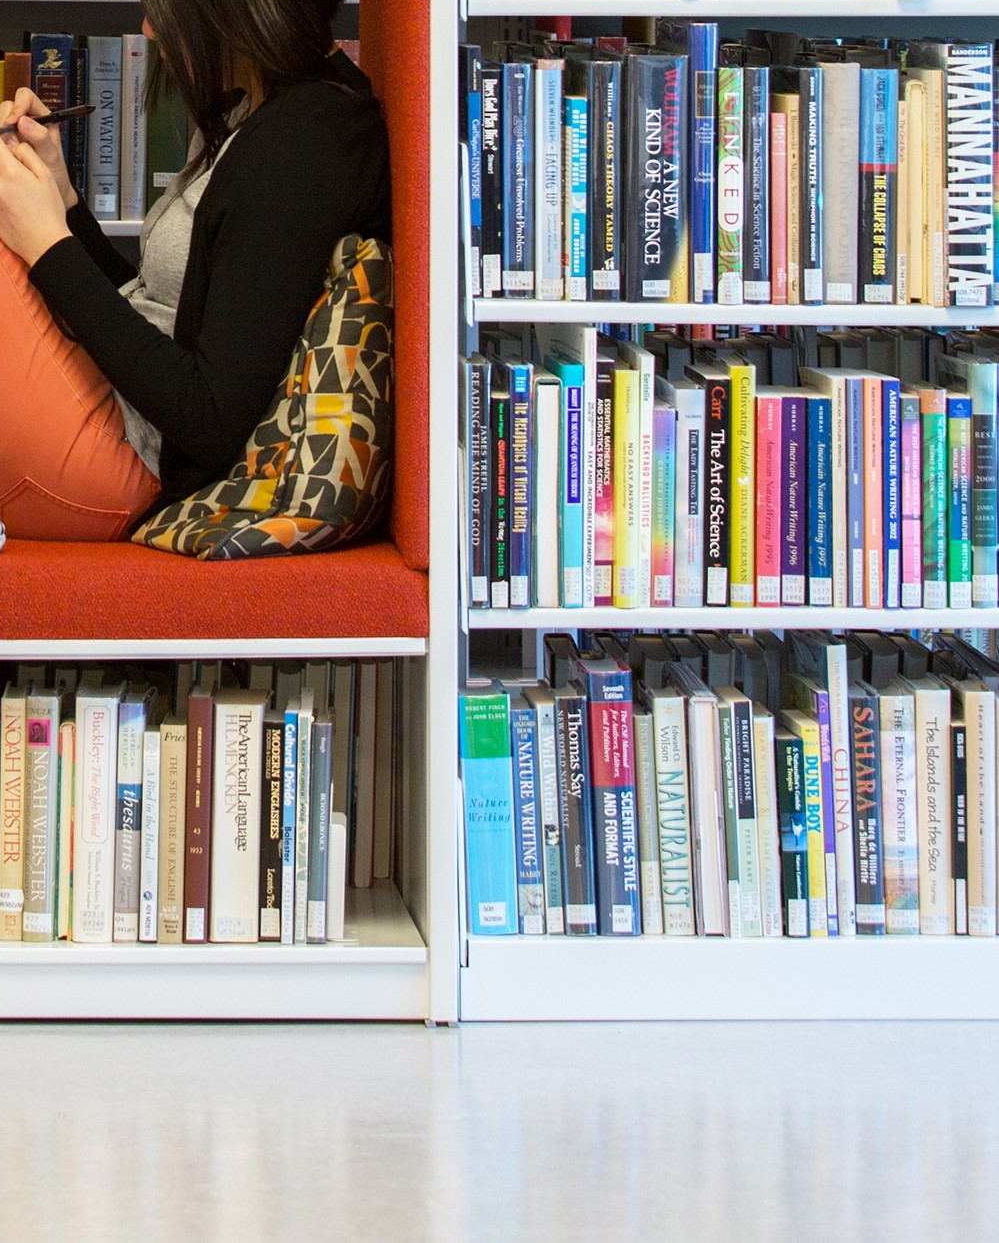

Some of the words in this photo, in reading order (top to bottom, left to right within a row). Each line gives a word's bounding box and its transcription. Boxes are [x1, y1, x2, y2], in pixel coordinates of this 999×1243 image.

[100, 90, 114, 110] ON
[663, 67, 679, 156] WOLFRAM
[99, 116, 114, 164] WATCH
[645, 108, 662, 155] KIND
[645, 160, 661, 184] OF
[663, 160, 678, 173] A
[948, 57, 993, 292] MANNAHATTA
[662, 178, 679, 220] NEW
[644, 187, 660, 265] SCIENCE
[710, 386, 725, 420] Carr
[710, 429, 725, 458] The
[710, 461, 725, 486] Art
[710, 488, 725, 500] of
[709, 502, 725, 548] Science
[602, 684, 624, 692] Seventh
[604, 692, 624, 700] Edition
[4, 714, 21, 772] NOAH
[270, 729, 281, 778] MODERN
[284, 724, 296, 768] Cultural
[566, 709, 582, 771] Thomas
[853, 707, 876, 812] SAHARA
[33, 750, 48, 805] NOAH
[284, 770, 295, 807] Divide
[518, 741, 534, 799] NATURE
[567, 773, 585, 799] Say
[804, 754, 820, 799] DUNE
[833, 747, 849, 834] CHINA
[3, 778, 21, 864] WEBSTER
[270, 781, 280, 839] ENGLISHES
[467, 811, 511, 823] Writing
[469, 798, 509, 808] Nature
[604, 792, 618, 816] AND
[620, 791, 636, 852] SCIENTIFIC
[805, 803, 821, 834] BOY
[520, 802, 536, 867] WRITING
[605, 819, 619, 866] FORMAT
[657, 770, 691, 908] NATURALIST
[31, 814, 47, 903] WEBSTER
[624, 853, 637, 891] STYLE
